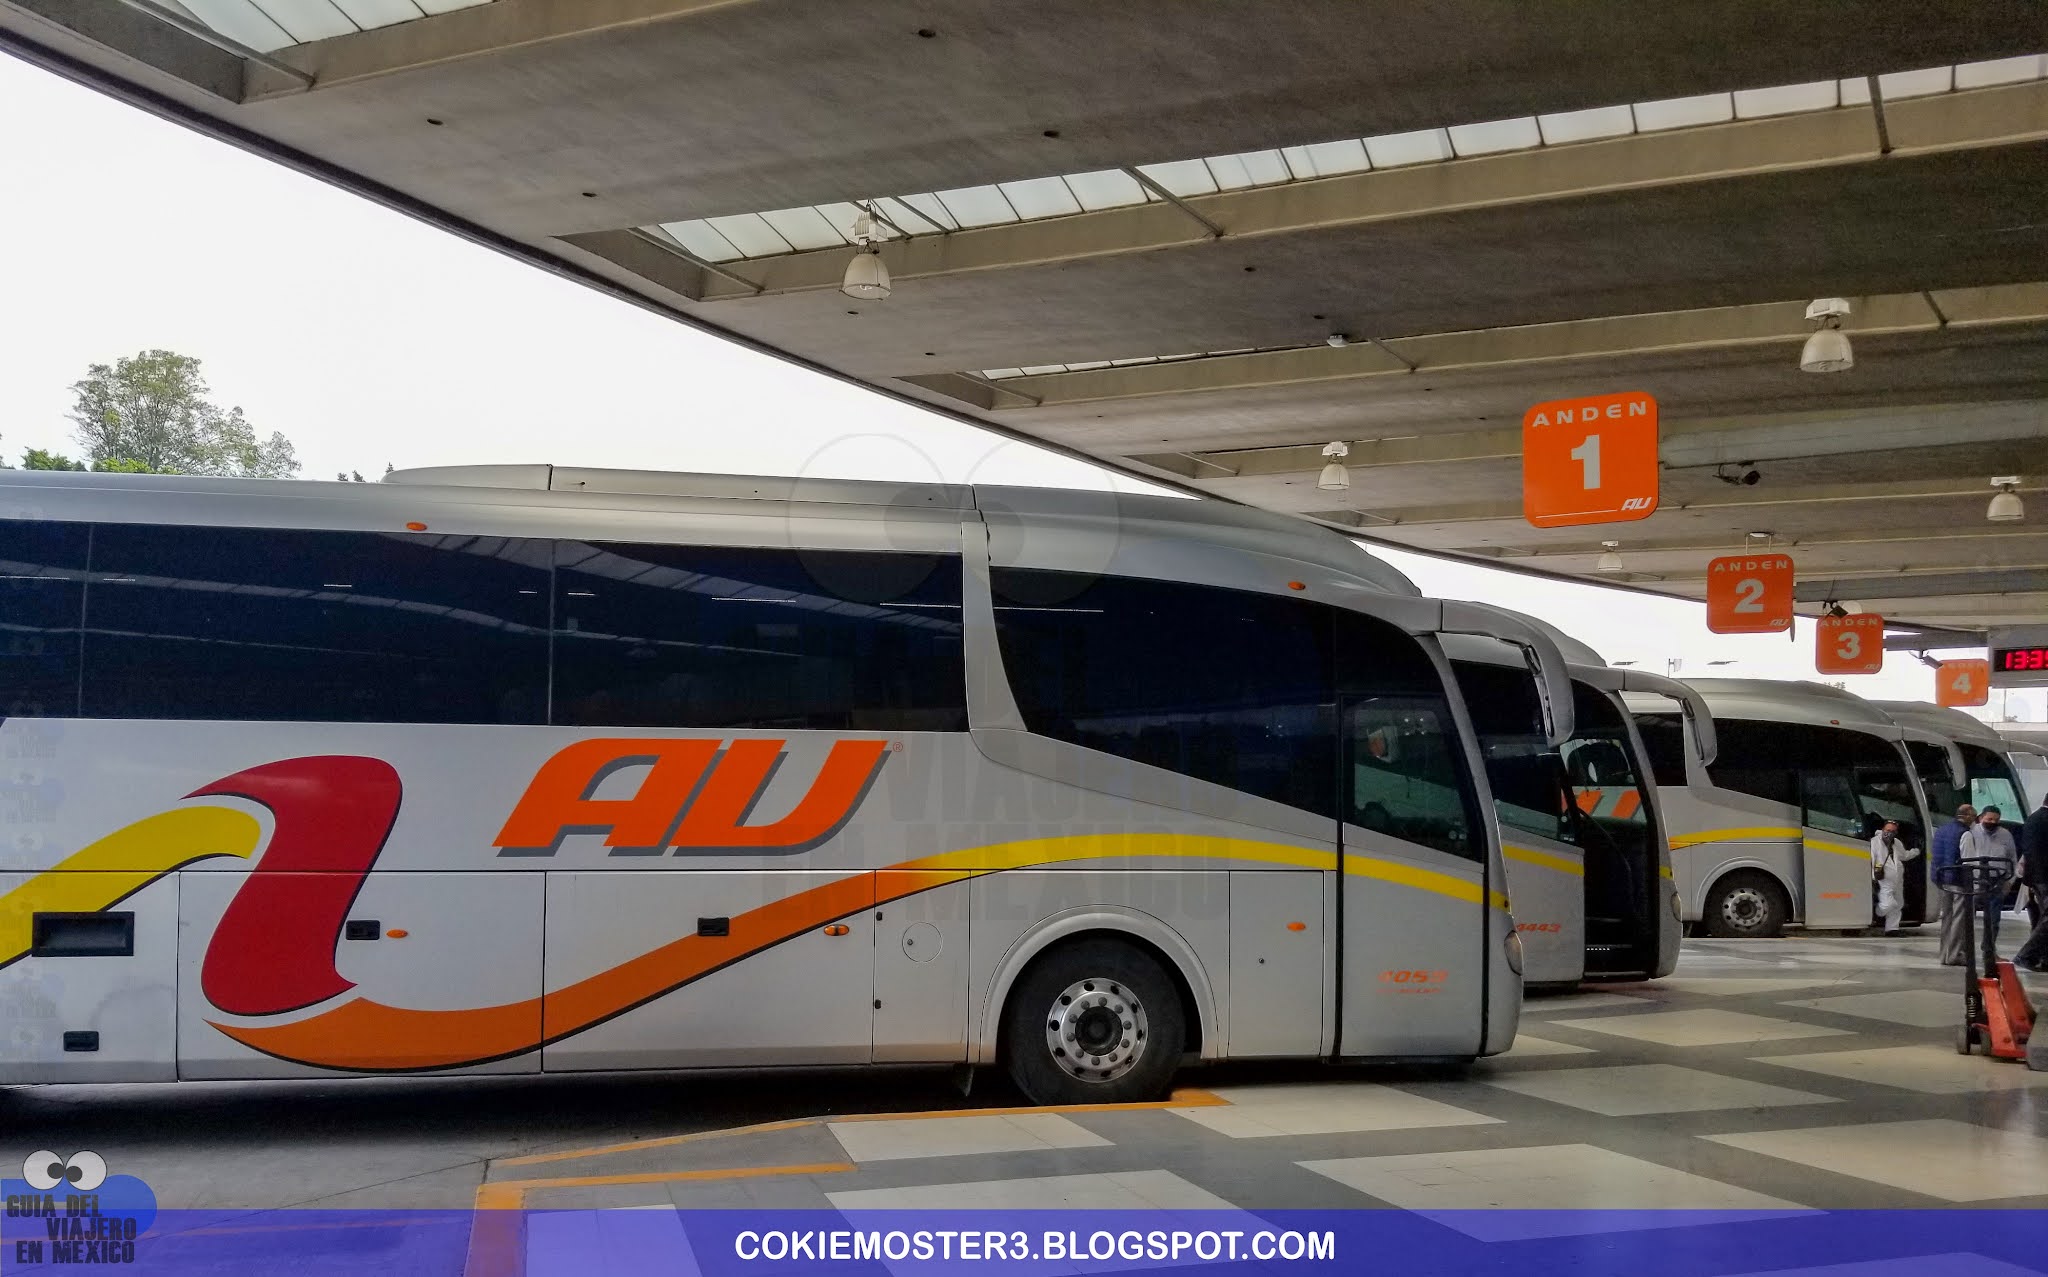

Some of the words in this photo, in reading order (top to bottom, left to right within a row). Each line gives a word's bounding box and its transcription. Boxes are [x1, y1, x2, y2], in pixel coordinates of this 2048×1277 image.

[1532, 401, 1646, 428] ANDEN
[1571, 434, 1600, 490] 1
[1621, 497, 1652, 511] AU
[1714, 560, 1787, 572] ANDEN
[1733, 578, 1765, 613] 2
[1821, 618, 1878, 627] ANDEN
[1837, 631, 1861, 660] 3
[1951, 672, 1971, 695] 4
[492, 738, 891, 856] AU
